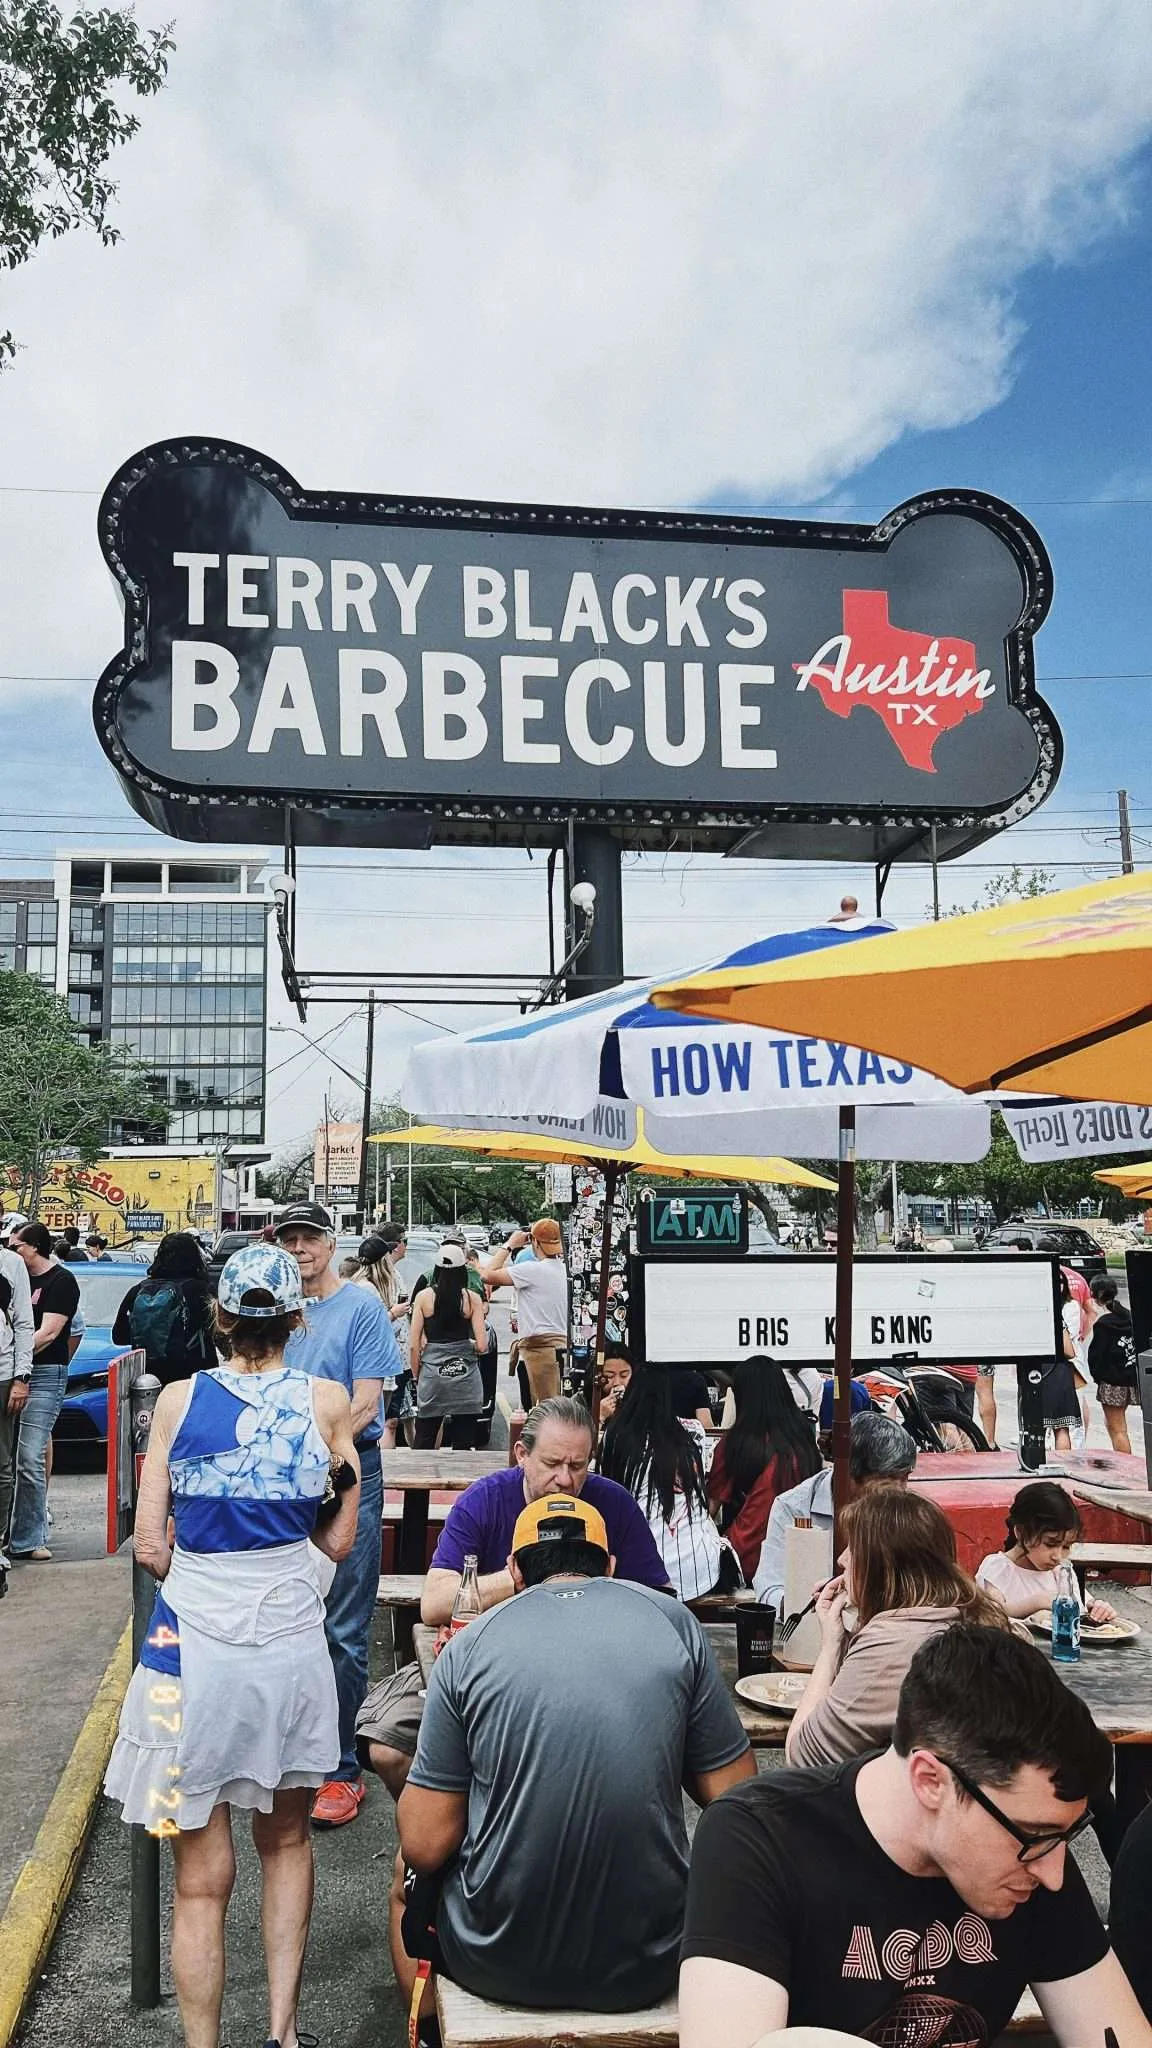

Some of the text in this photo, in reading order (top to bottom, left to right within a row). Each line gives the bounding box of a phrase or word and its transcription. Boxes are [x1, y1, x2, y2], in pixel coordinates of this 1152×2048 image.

[172, 552, 768, 649] TERRY BLACK'S
[796, 635, 996, 699] Austin
[171, 641, 777, 769] BARBECUE
[888, 704, 937, 725] TX
[652, 1043, 752, 1098] HOW
[45, 1212, 100, 1228] JERY
[656, 1204, 736, 1237] ATM
[890, 1315, 932, 1345] KING
